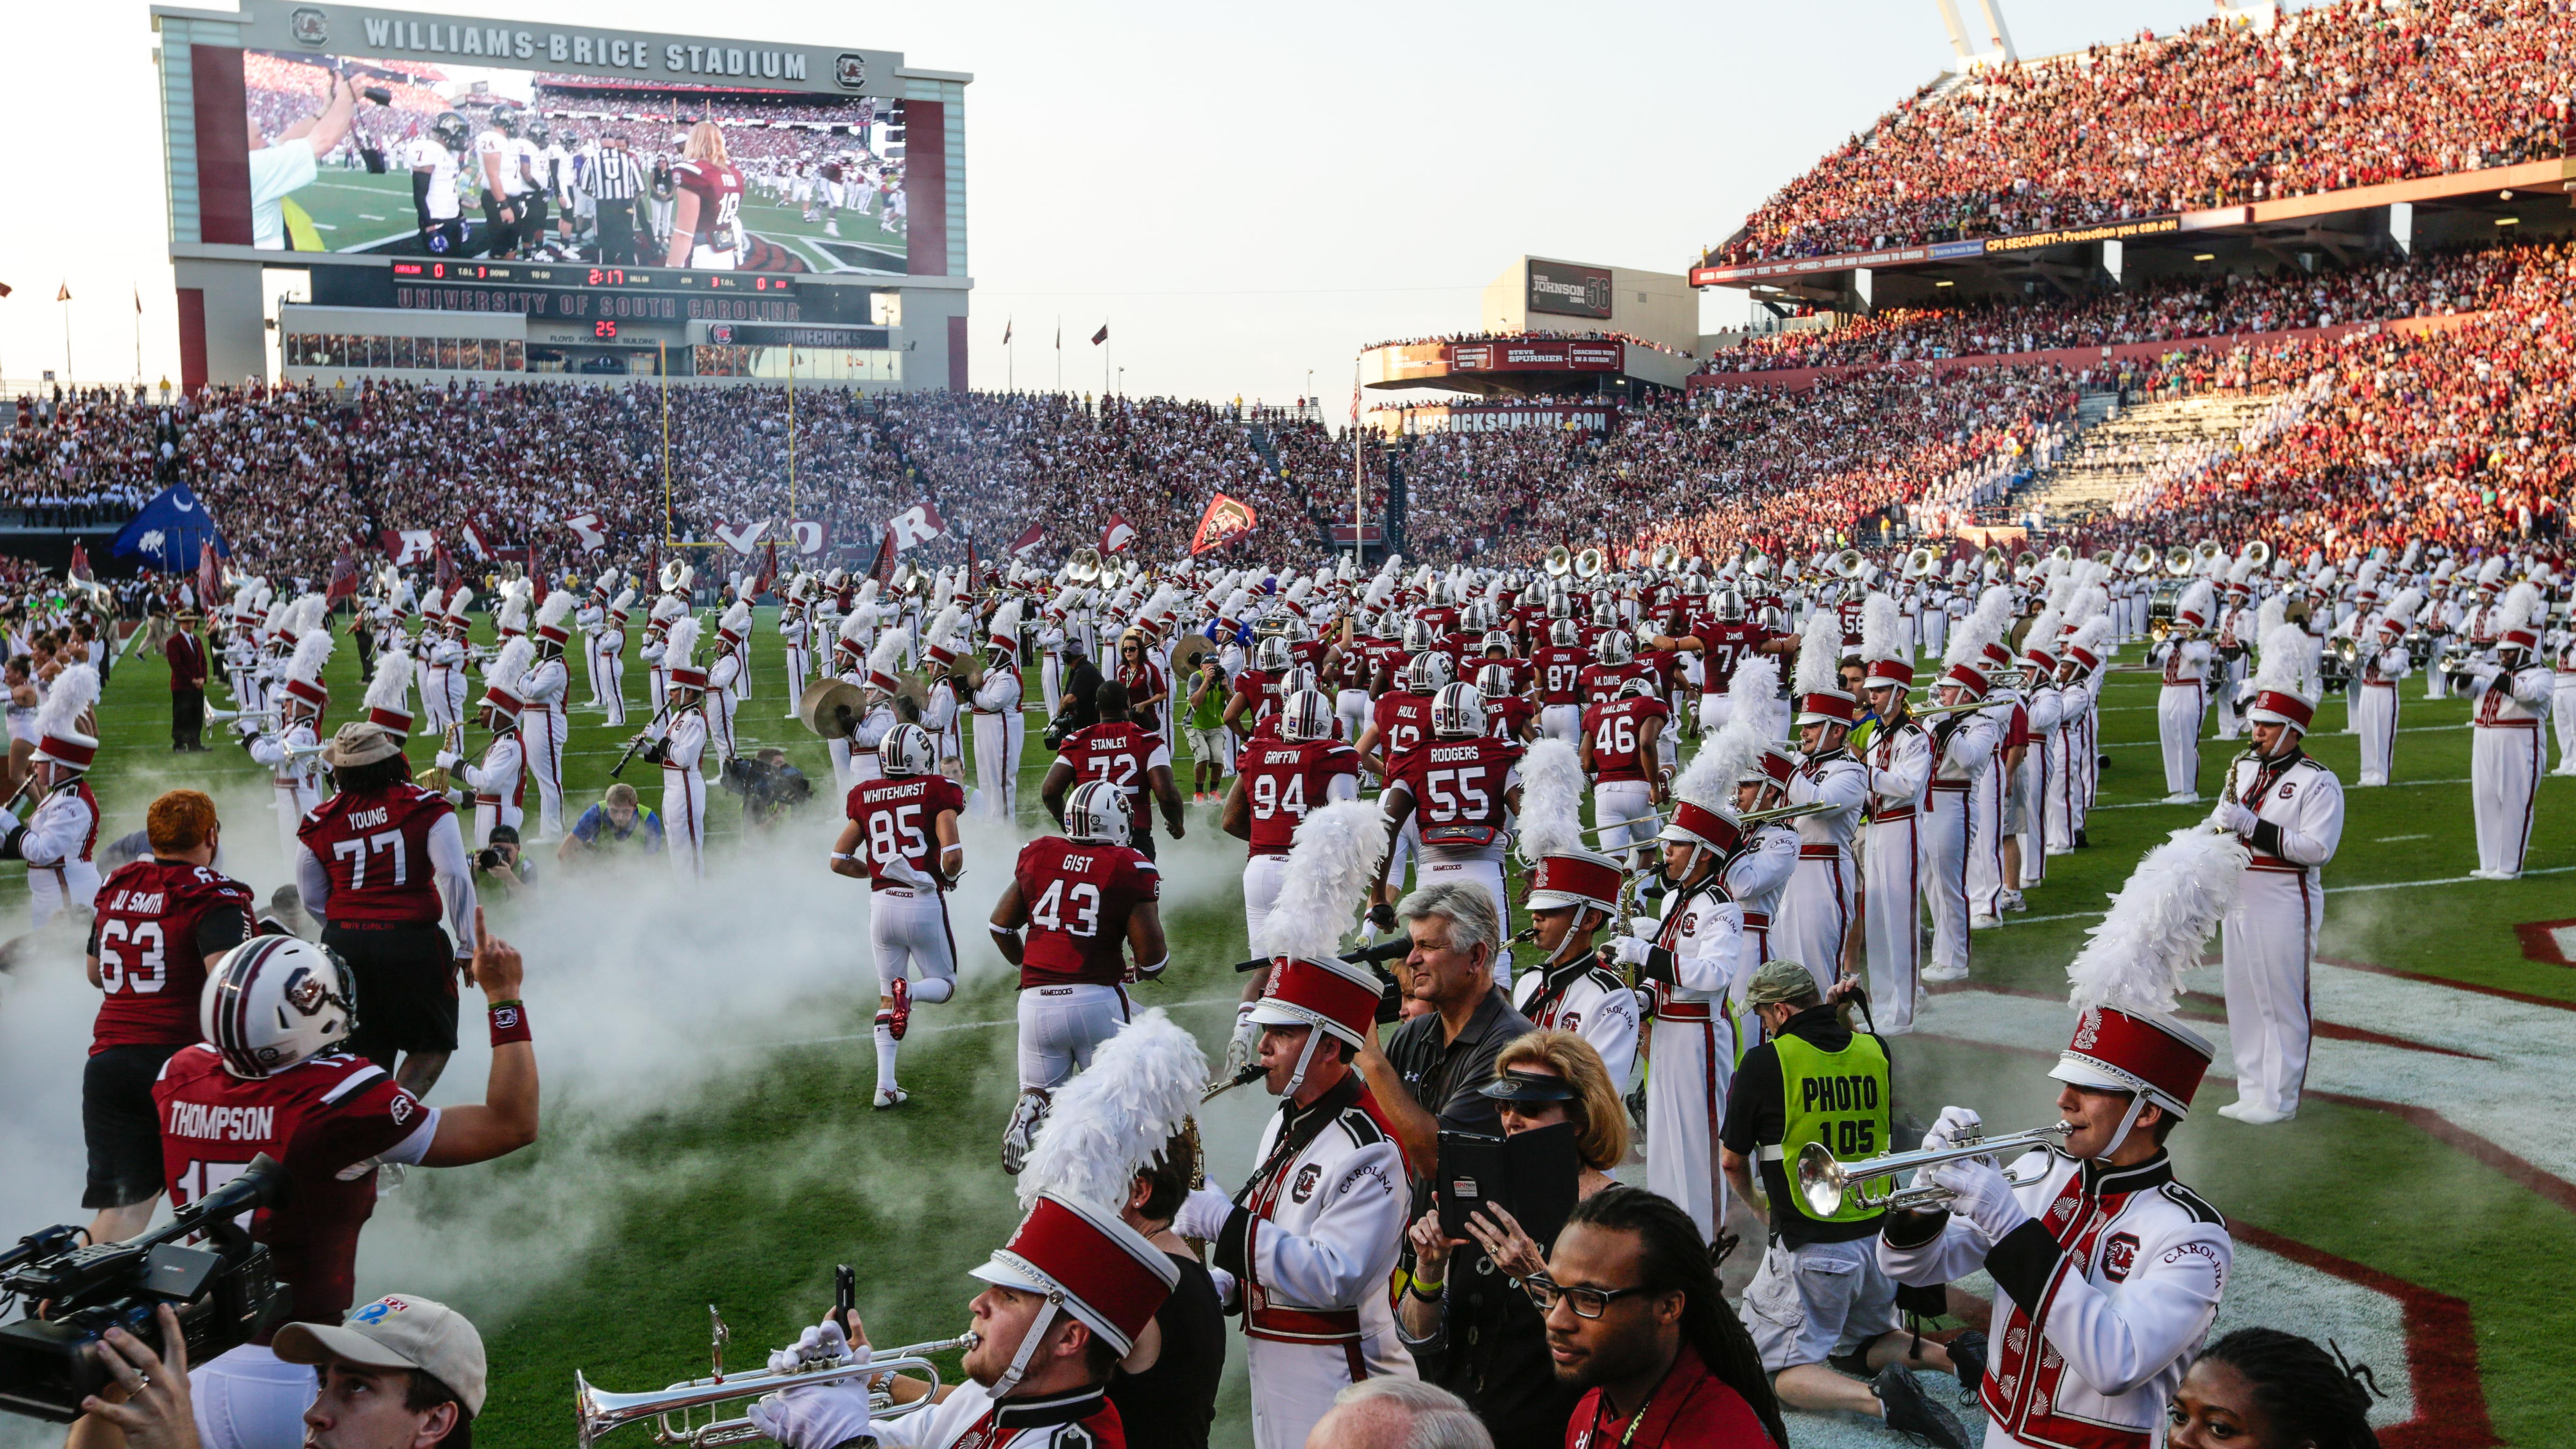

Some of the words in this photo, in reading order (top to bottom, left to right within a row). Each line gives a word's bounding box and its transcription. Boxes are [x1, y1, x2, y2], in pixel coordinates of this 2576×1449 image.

[364, 17, 648, 68] WILLIAMS-BRICE
[665, 43, 806, 80] STADIUM
[1986, 240, 2004, 252] CPI
[2062, 226, 2117, 243] Protection
[2117, 223, 2137, 238] you
[2138, 221, 2158, 233] can
[434, 263, 444, 279] 0
[489, 269, 510, 277] DOWN
[531, 271, 540, 279] TO
[540, 271, 551, 280] GO
[1699, 272, 1715, 281] NEED
[1715, 268, 1755, 280] ASSISTANCE?
[1757, 266, 1771, 275] TEXT
[1824, 259, 1843, 268] ISSUE
[1843, 257, 1858, 266] AND
[1858, 253, 1890, 265] LOCATION
[1891, 251, 1900, 260] TO
[589, 268, 624, 286] 2:17
[757, 277, 766, 291] 0
[1533, 281, 1585, 297] JOHNSON
[1586, 276, 1610, 310] 56
[398, 287, 548, 313] UNIVERSITY
[560, 294, 589, 316] OF
[599, 296, 675, 318] SOUTH
[687, 298, 800, 322] CAROLINA
[595, 321, 617, 337] 25
[774, 328, 864, 347] GAMECOCKS
[550, 334, 575, 343] FLOYD
[579, 335, 617, 345] FOOTBALL
[623, 337, 656, 346] BUILDING
[1508, 355, 1563, 363] SPURRIER
[889, 506, 939, 552] R
[1726, 631, 1744, 641] ZANDI
[1293, 649, 1309, 660] TTER
[1553, 654, 1571, 662] ODOM
[1547, 664, 1578, 692] 87
[1594, 676, 1602, 686] M.
[1603, 675, 1621, 686] DAVIS
[1262, 683, 1281, 693] TURN
[1397, 705, 1417, 719] HULL
[1600, 702, 1631, 715] MALONE
[1091, 735, 1128, 750] STANLEY
[1596, 715, 1636, 755] 46
[1264, 750, 1301, 765] GRIFFIN
[1430, 745, 1480, 763] RODGERS
[1088, 753, 1139, 795] 72
[863, 781, 927, 804] WHITEHURST
[1253, 773, 1308, 820] 94
[1426, 766, 1490, 823] 55
[347, 806, 388, 831] YOUNG
[868, 804, 928, 864] 85
[332, 828, 406, 890] 77
[1062, 854, 1094, 874] GIST
[1269, 855, 1290, 863] GAMECO
[1432, 863, 1462, 872] GAMECOCKS
[110, 889, 126, 911] JU.
[128, 891, 164, 914] SMITH
[885, 889, 914, 898] GAMECOCKS
[1031, 879, 1100, 938] 43
[1706, 915, 1738, 934] CAROLINA
[99, 918, 165, 994] 63
[1040, 987, 1073, 997] GAMECOCKS
[1802, 1075, 1877, 1113] PHOTO
[169, 1101, 274, 1141] THOMPSON
[1819, 1119, 1876, 1156] 105
[1340, 1166, 1393, 1196] CAROLINA
[2164, 1242, 2222, 1290] CAROLINA
[377, 1297, 406, 1311] LTX
